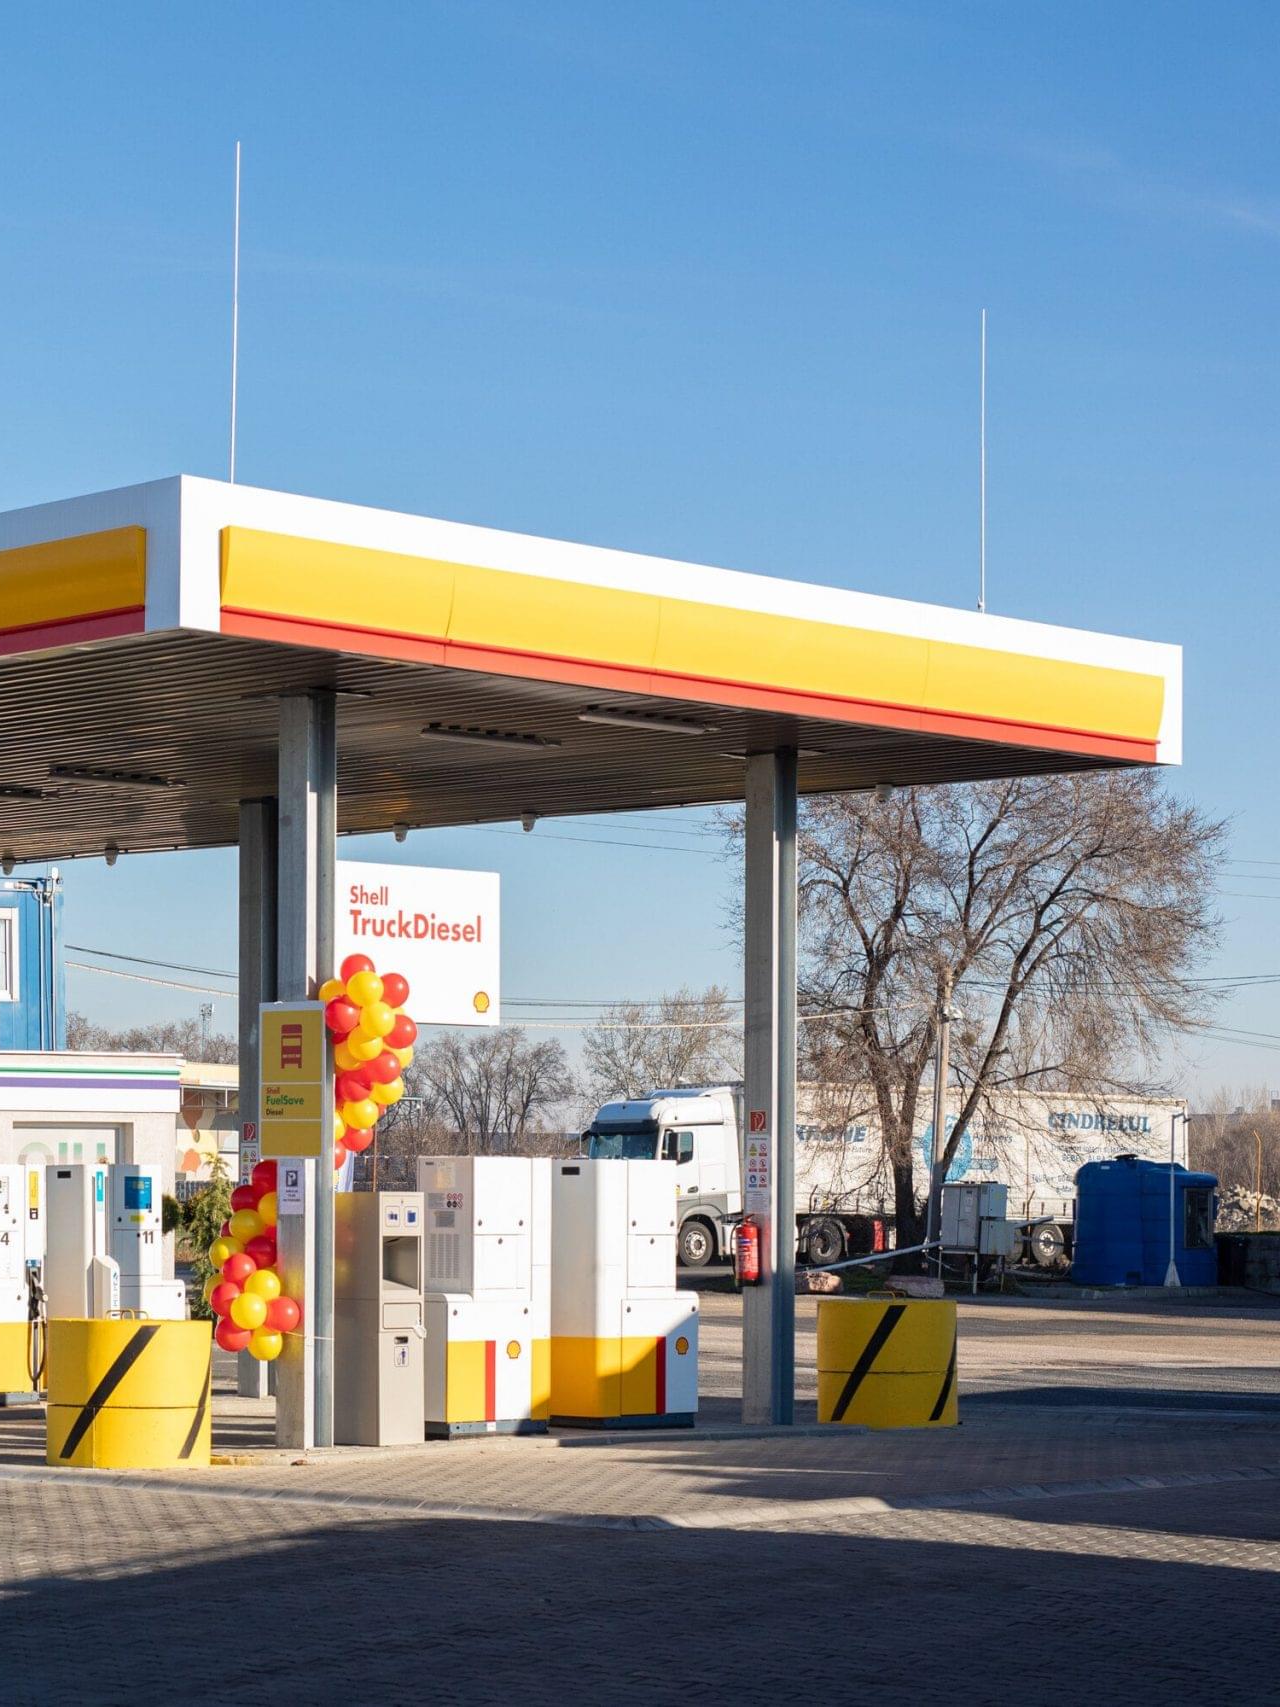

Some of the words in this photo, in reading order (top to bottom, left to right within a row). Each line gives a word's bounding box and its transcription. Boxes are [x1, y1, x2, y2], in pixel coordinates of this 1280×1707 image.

[350, 884, 388, 906] Shell
[350, 909, 482, 942] TruckDiesel
[266, 1087, 280, 1095] Shell
[266, 1095, 304, 1105] FuelSave
[266, 1108, 284, 1116] Diesel
[0, 1232, 10, 1245] 4
[143, 1231, 154, 1244] 11
